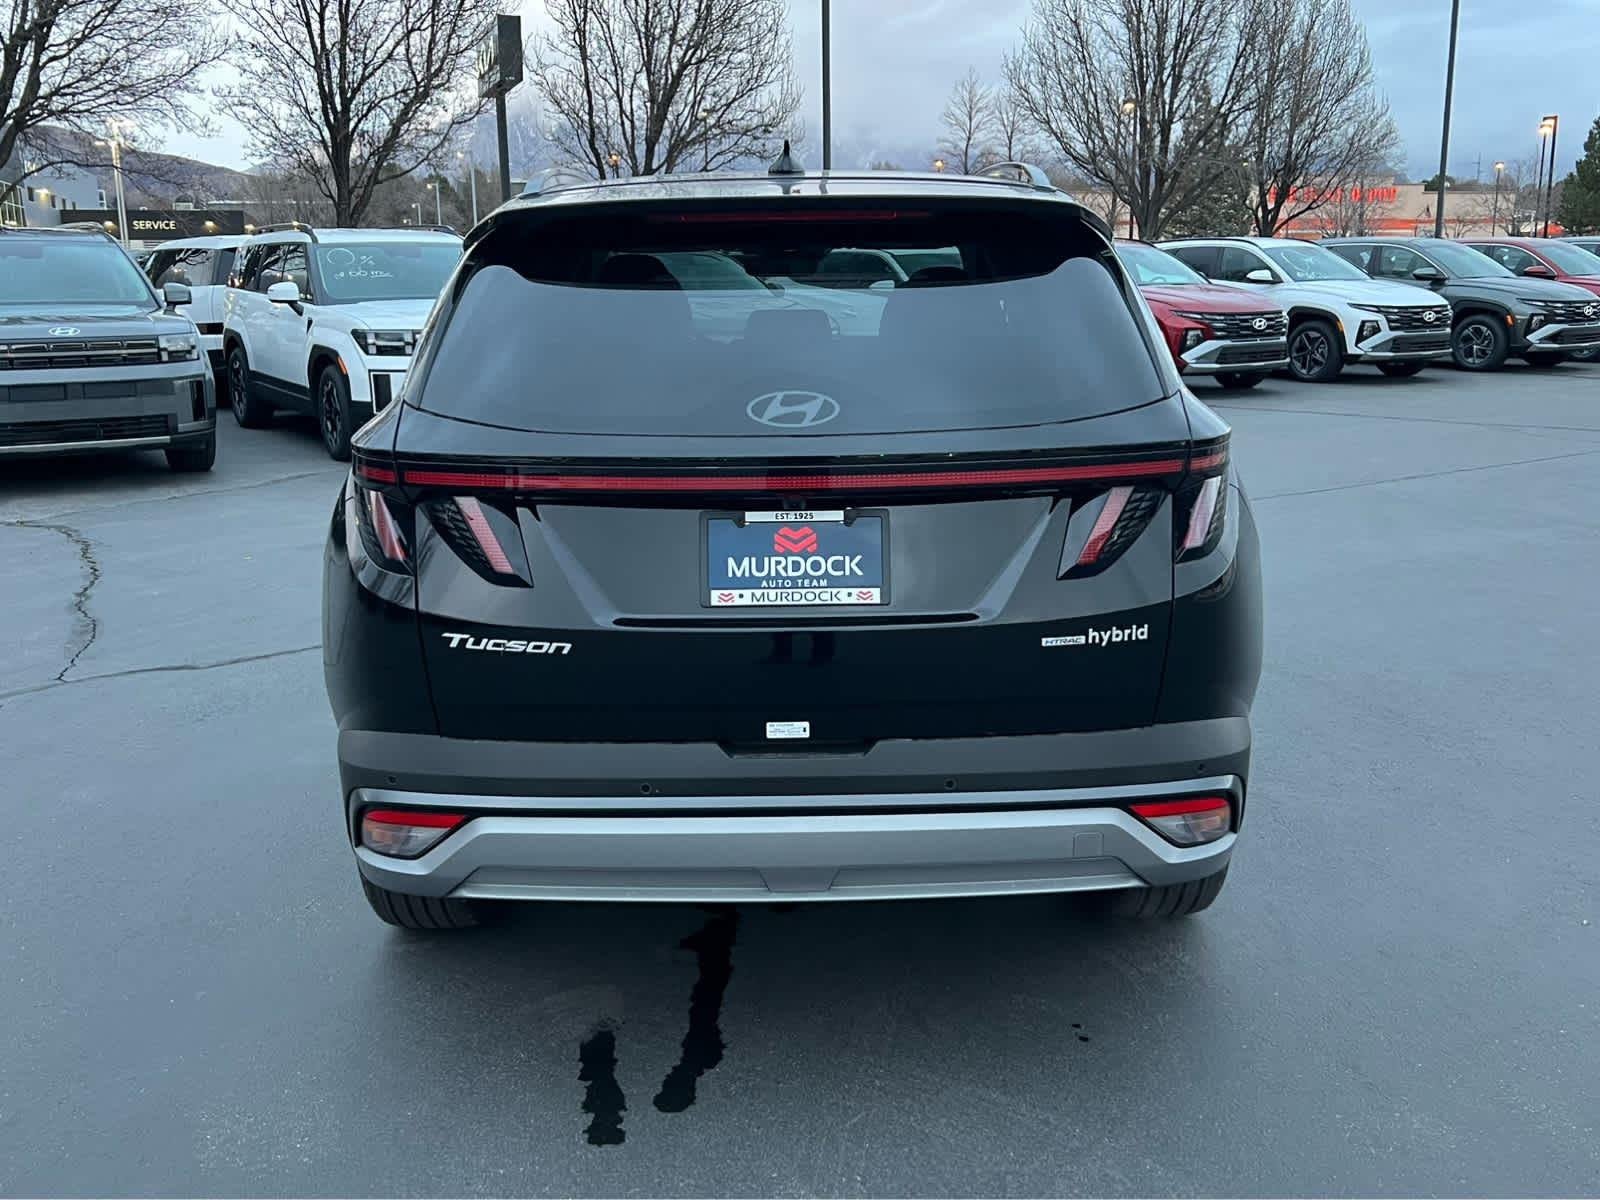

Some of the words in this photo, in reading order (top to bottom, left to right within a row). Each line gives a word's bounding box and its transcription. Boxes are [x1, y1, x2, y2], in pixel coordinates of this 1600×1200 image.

[132, 220, 176, 230] SERVICE
[775, 512, 792, 520] EST.
[794, 512, 814, 520] 1925
[727, 555, 863, 578] MURDOCK
[761, 579, 792, 588] AUTO
[797, 578, 828, 587] TEAM
[751, 590, 842, 603] MURDOCK
[1088, 624, 1149, 647] hybrid
